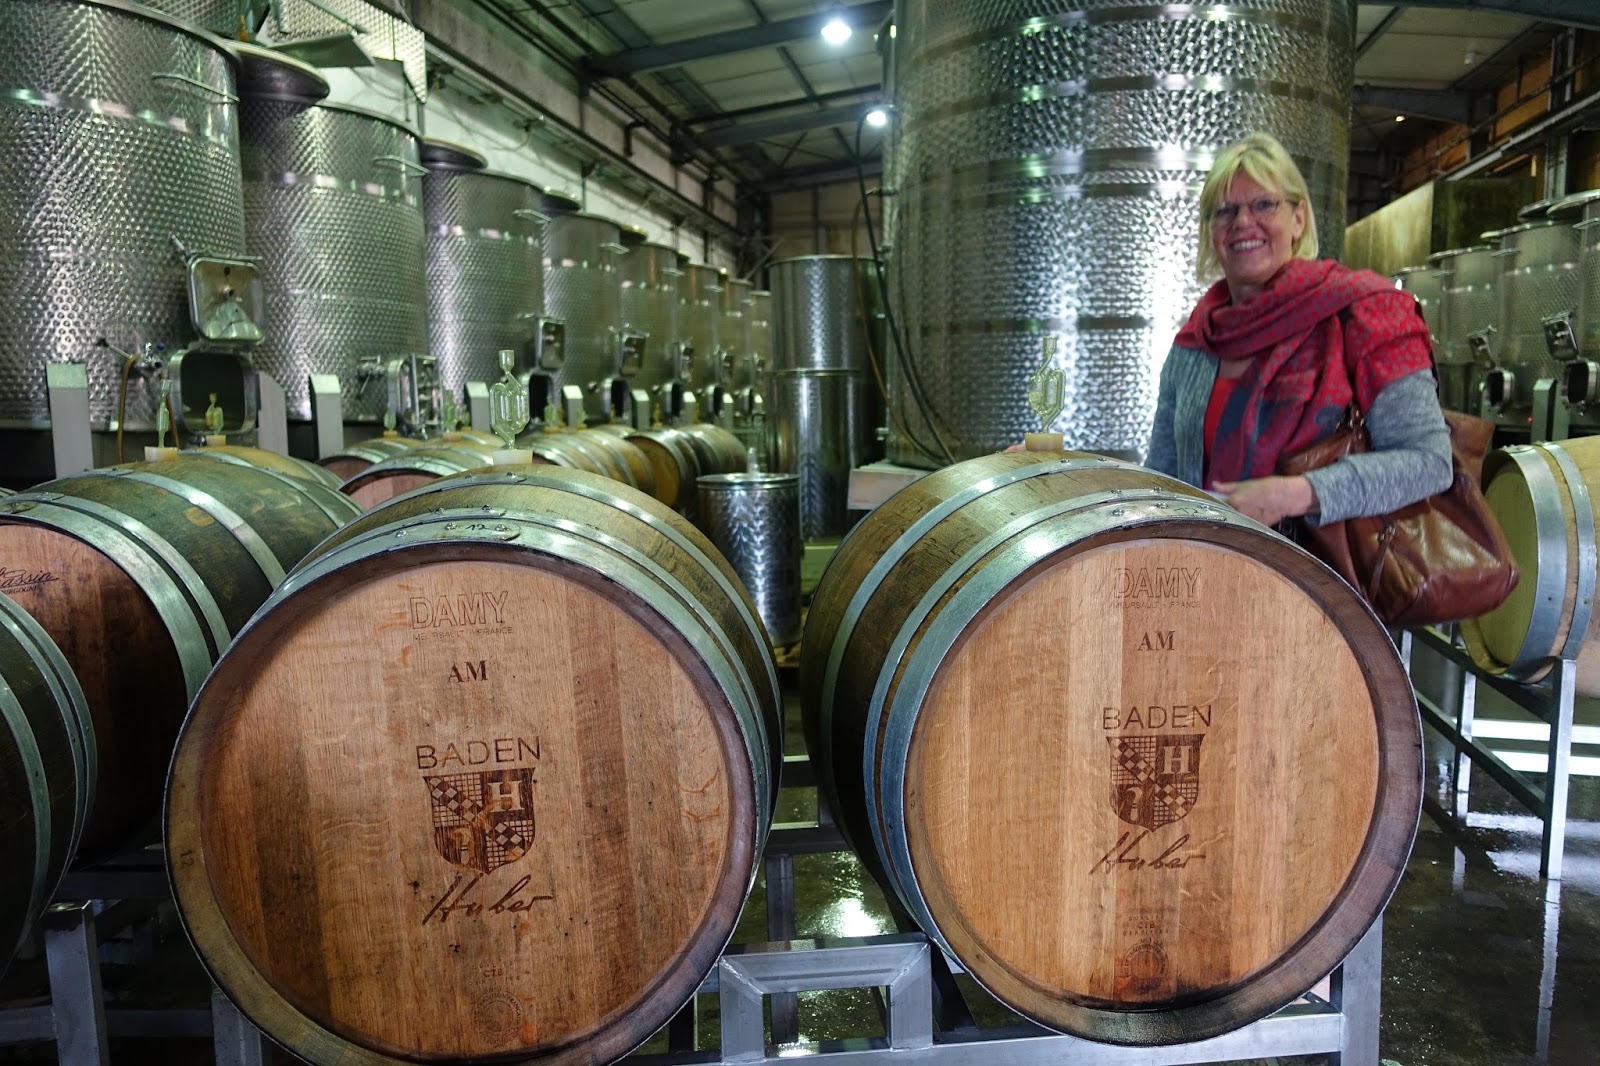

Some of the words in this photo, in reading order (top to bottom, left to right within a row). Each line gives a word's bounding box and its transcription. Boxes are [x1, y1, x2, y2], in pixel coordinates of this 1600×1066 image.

[1113, 567, 1202, 599] DAMY
[409, 590, 509, 630] DAMY
[1137, 630, 1176, 651] AM
[447, 659, 489, 684] AM
[1102, 704, 1212, 730] BADEN
[415, 735, 541, 770] BADEN
